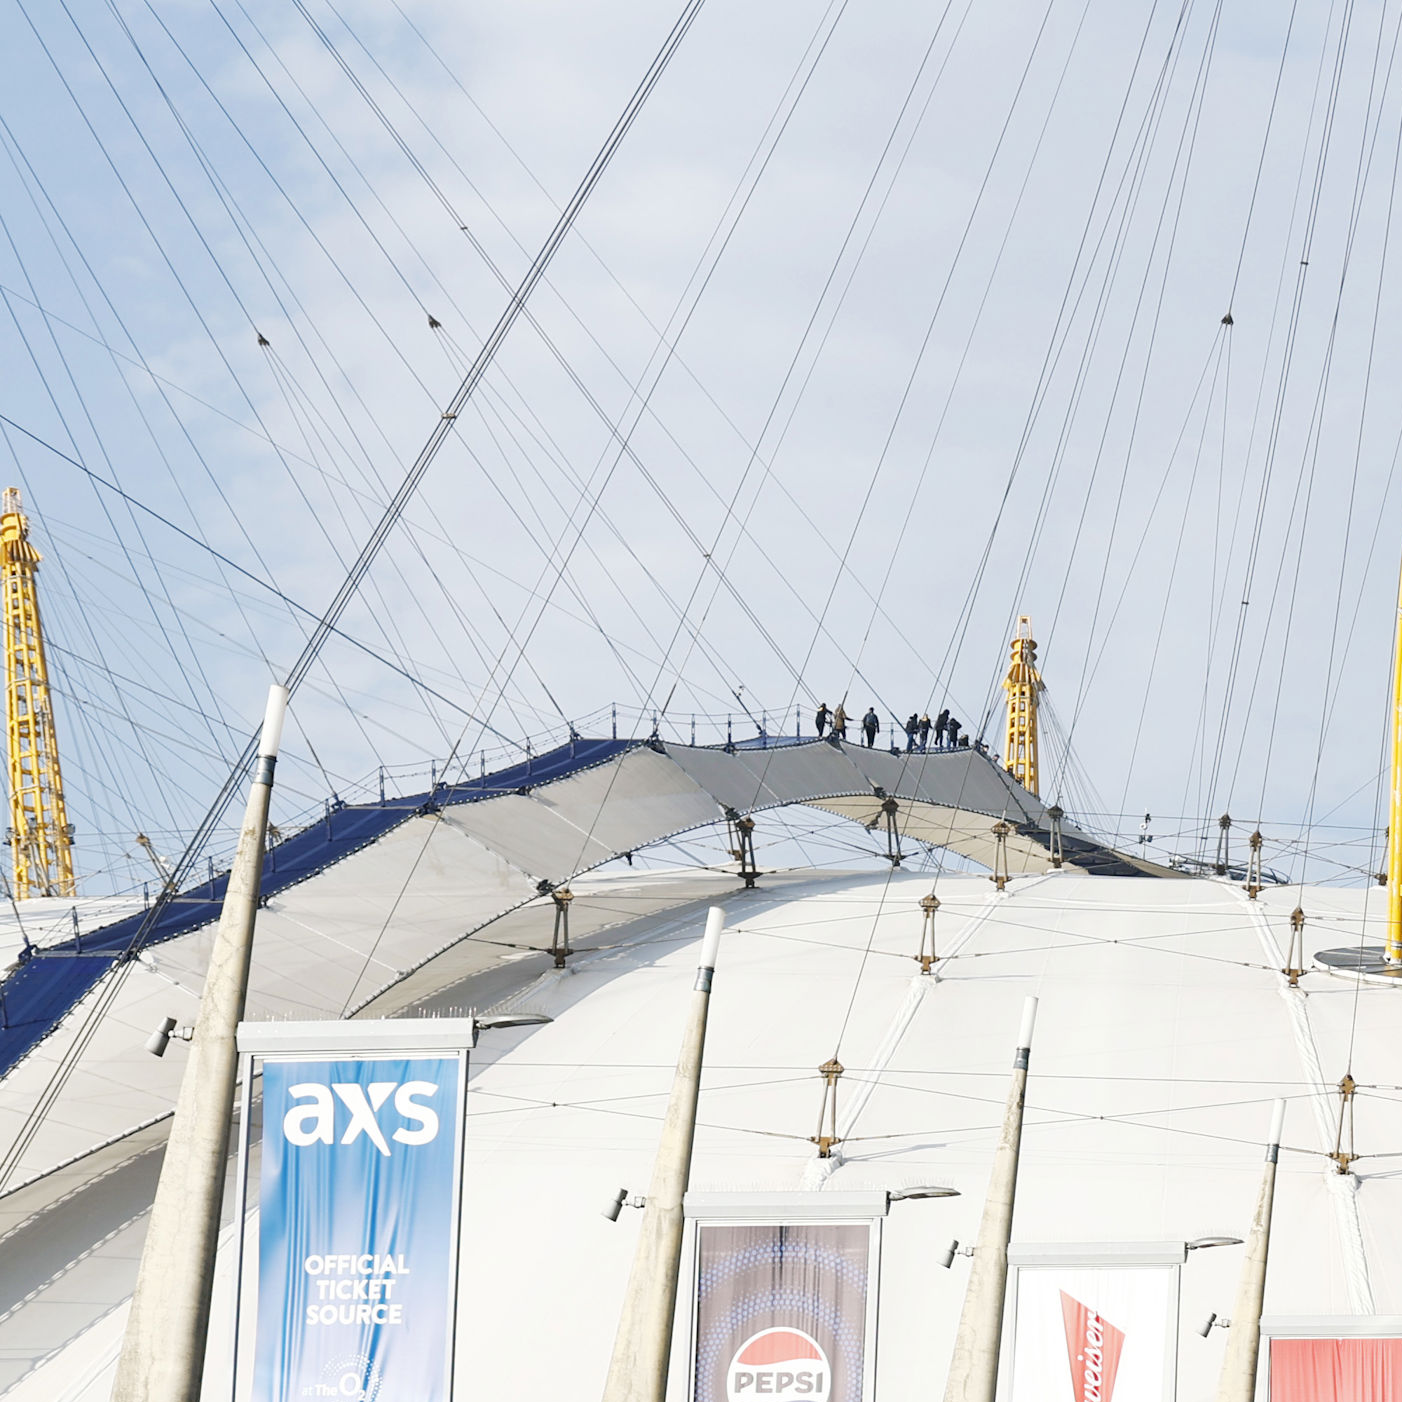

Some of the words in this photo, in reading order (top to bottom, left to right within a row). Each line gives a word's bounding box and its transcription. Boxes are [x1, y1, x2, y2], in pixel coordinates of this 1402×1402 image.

[283, 1080, 439, 1157] axs
[304, 1254, 410, 1276] OFFICIAL
[316, 1278, 396, 1301] TICKET
[306, 1304, 402, 1326] SOURCE
[315, 1383, 338, 1397] The
[734, 1370, 825, 1395] PEPSI
